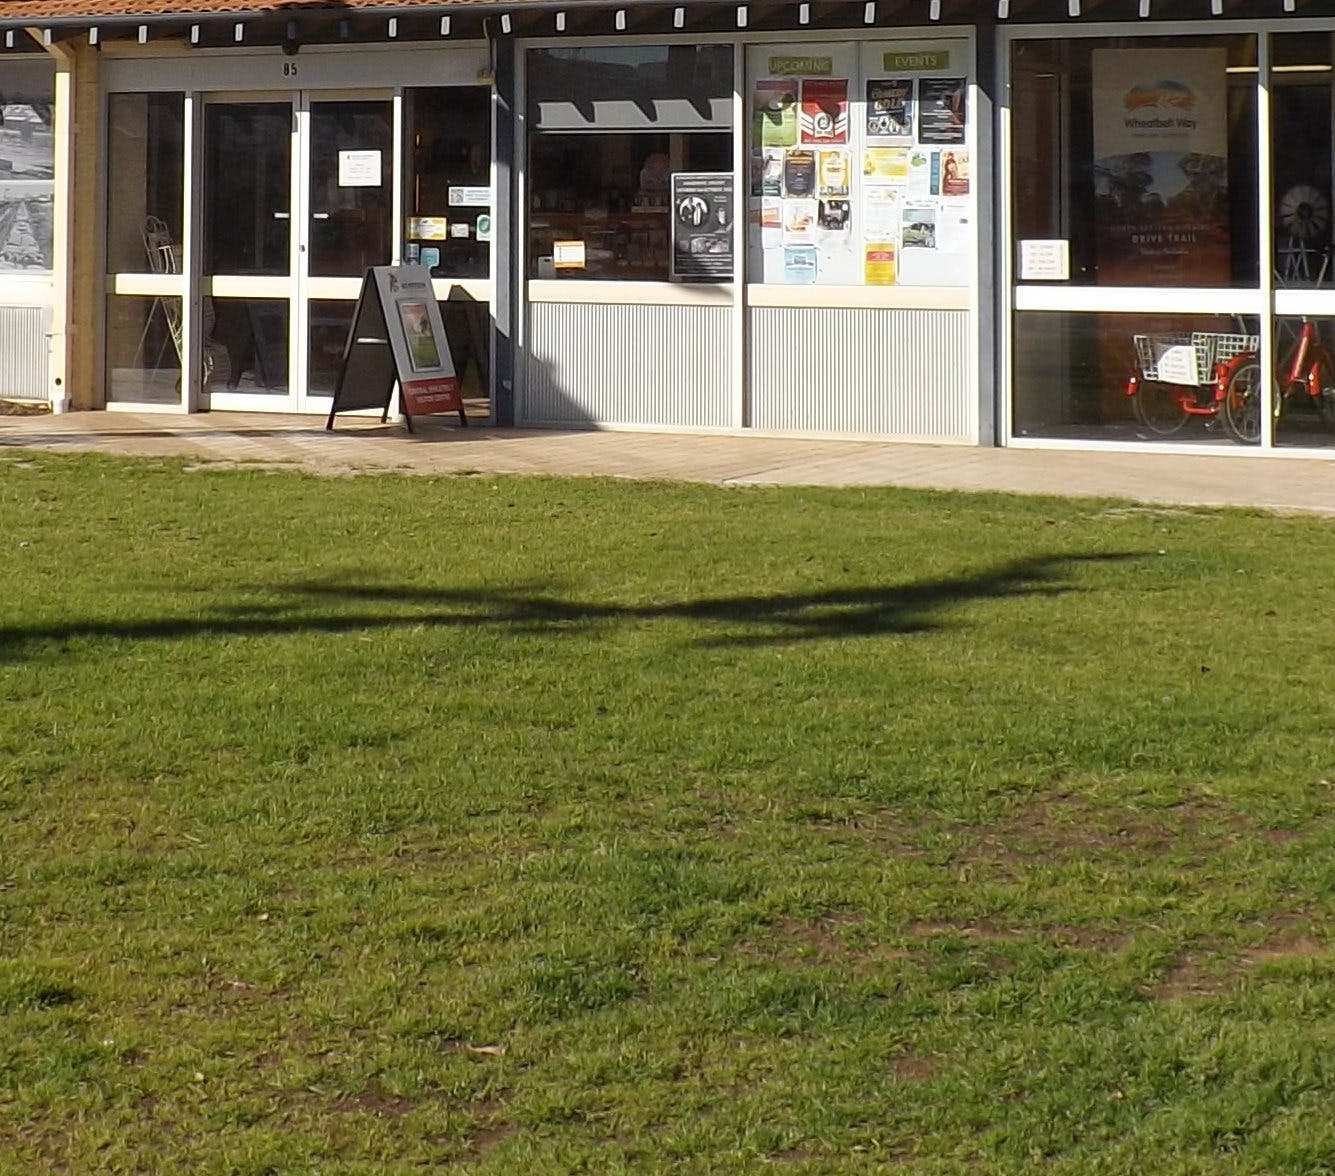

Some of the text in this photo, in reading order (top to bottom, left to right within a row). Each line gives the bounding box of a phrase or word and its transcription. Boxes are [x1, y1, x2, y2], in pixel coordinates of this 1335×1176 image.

[769, 53, 937, 71] UPCOMING EVENTS
[1124, 117, 1197, 131] Wheatbelt Way
[1131, 233, 1197, 244] DRIVE TRAIL
